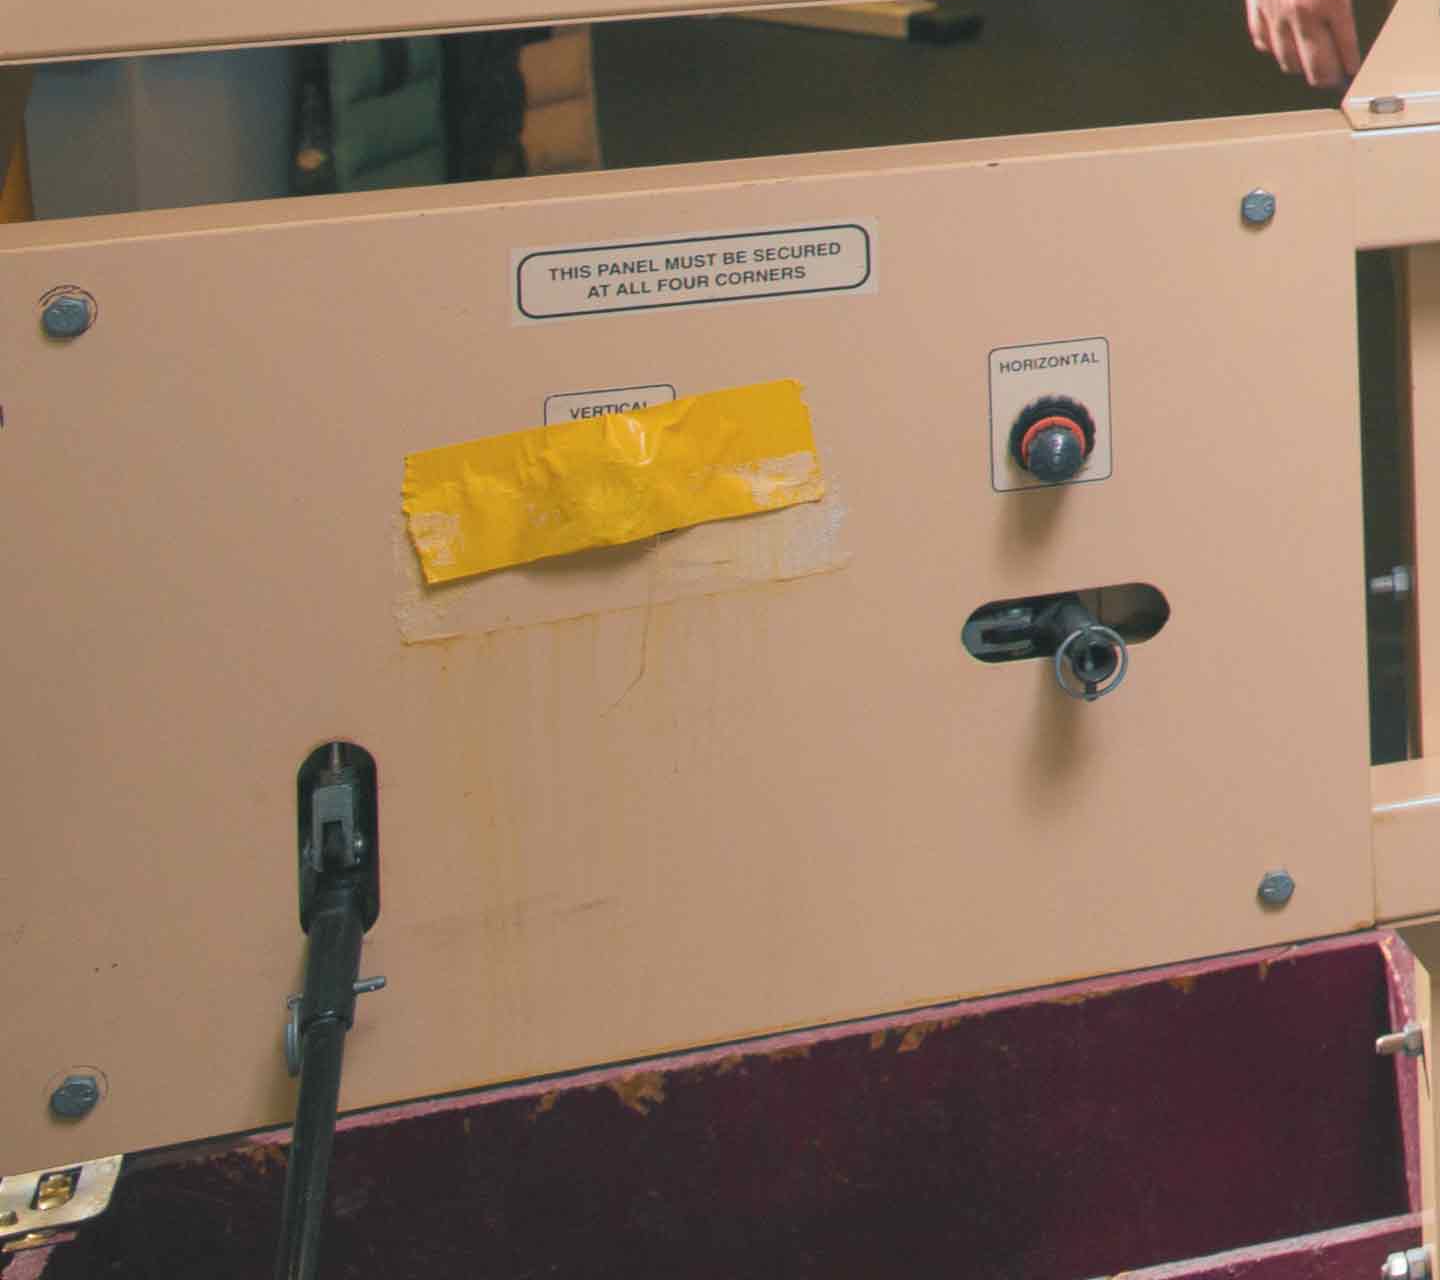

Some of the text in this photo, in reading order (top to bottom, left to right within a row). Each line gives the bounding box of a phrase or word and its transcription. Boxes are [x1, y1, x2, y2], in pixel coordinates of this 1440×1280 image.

[548, 242, 841, 281] THIS PANEL MUST BE SECURED
[587, 266, 806, 299] AT ALL FOUR CORNERS
[999, 351, 1100, 374] HORIZONTAL
